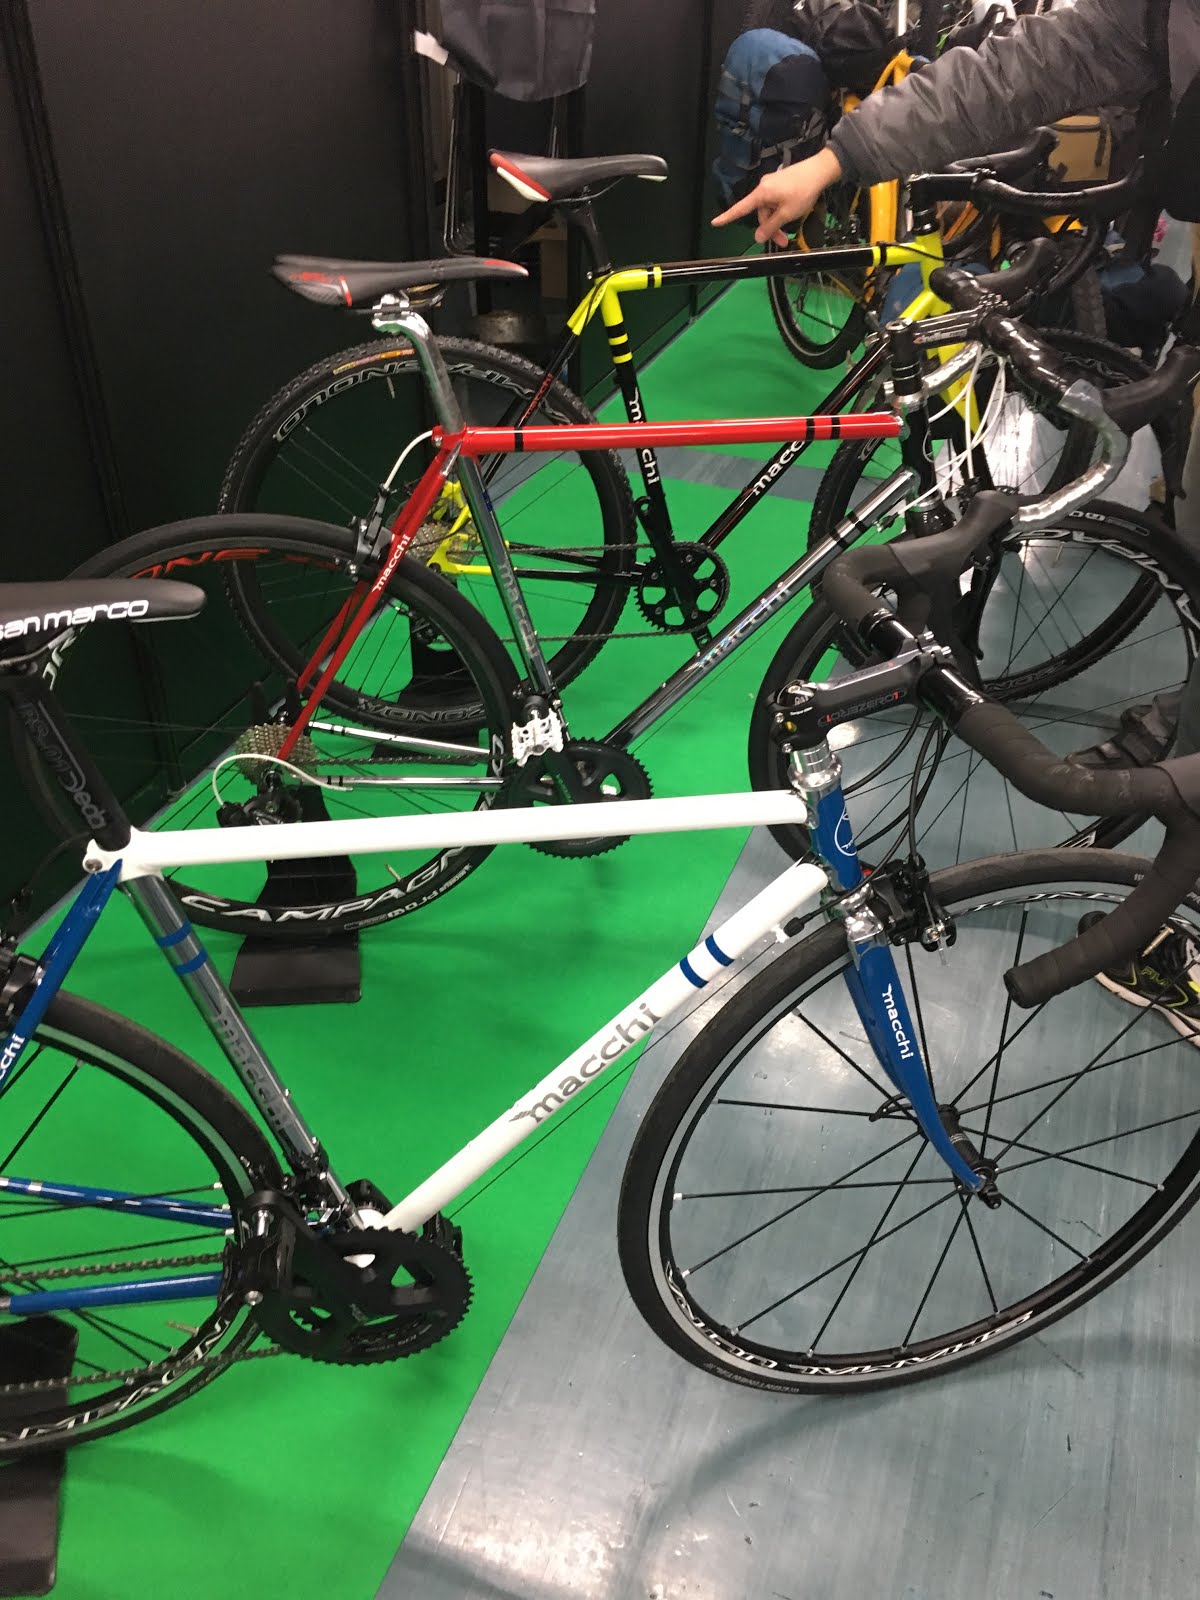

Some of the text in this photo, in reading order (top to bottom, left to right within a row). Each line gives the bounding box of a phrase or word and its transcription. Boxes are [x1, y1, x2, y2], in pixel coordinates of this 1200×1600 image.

[628, 386, 660, 486] mchi
[751, 439, 806, 496] macc
[371, 533, 412, 593] macchi
[43, 599, 150, 632] marco
[499, 560, 542, 659] macchi
[508, 1001, 664, 1127] macchi
[880, 982, 917, 1062] macchi
[206, 1007, 289, 1134] macchi
